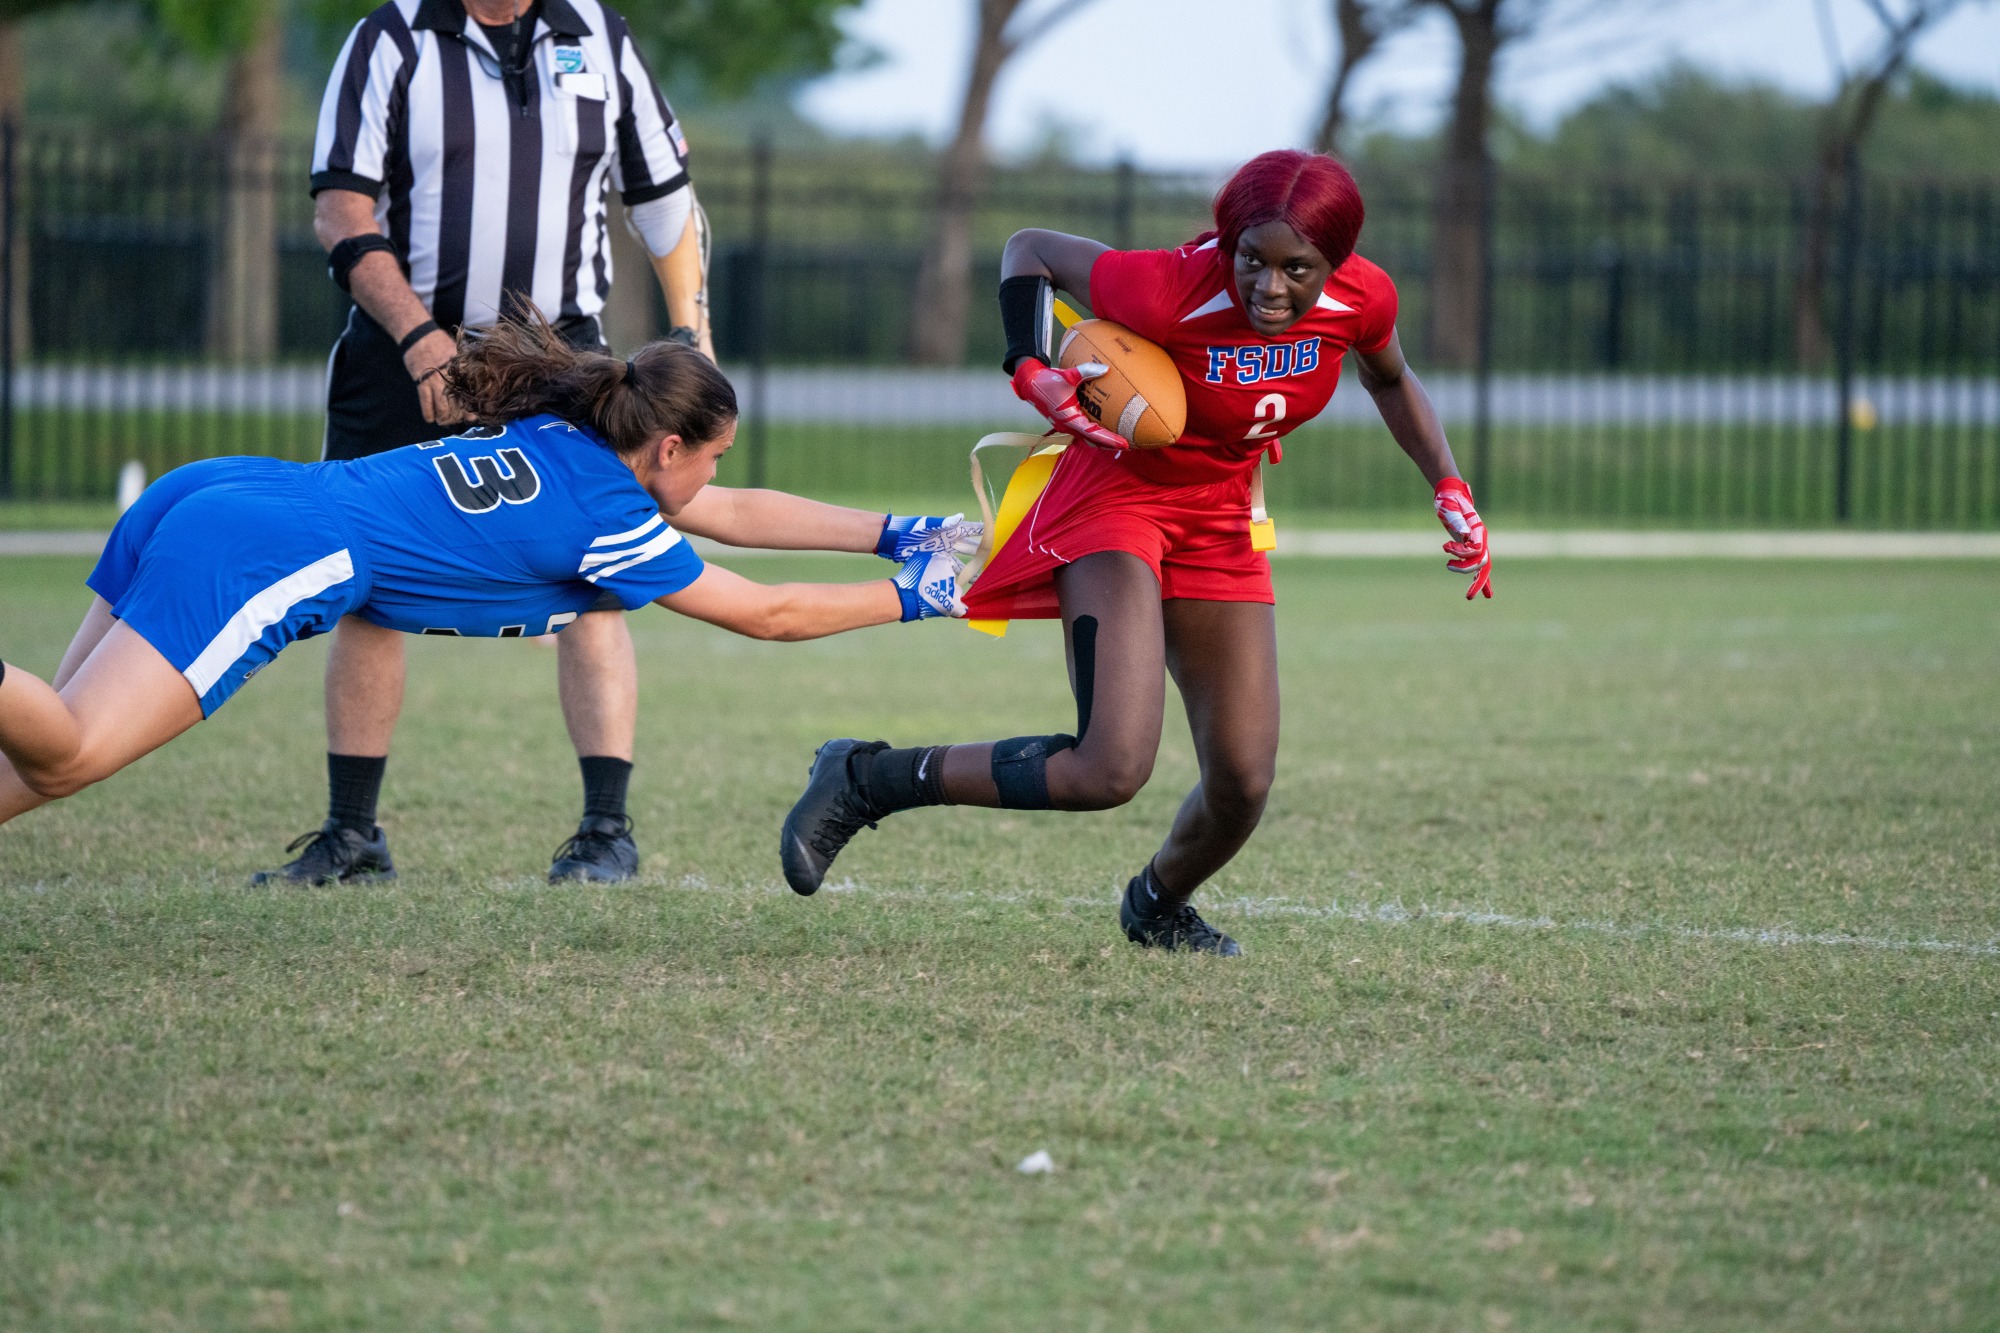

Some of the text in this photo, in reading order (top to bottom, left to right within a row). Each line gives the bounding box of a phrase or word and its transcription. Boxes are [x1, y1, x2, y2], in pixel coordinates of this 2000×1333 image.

[1205, 336, 1321, 385] FSDB
[1242, 393, 1287, 440] 2
[924, 585, 954, 613] adidas
